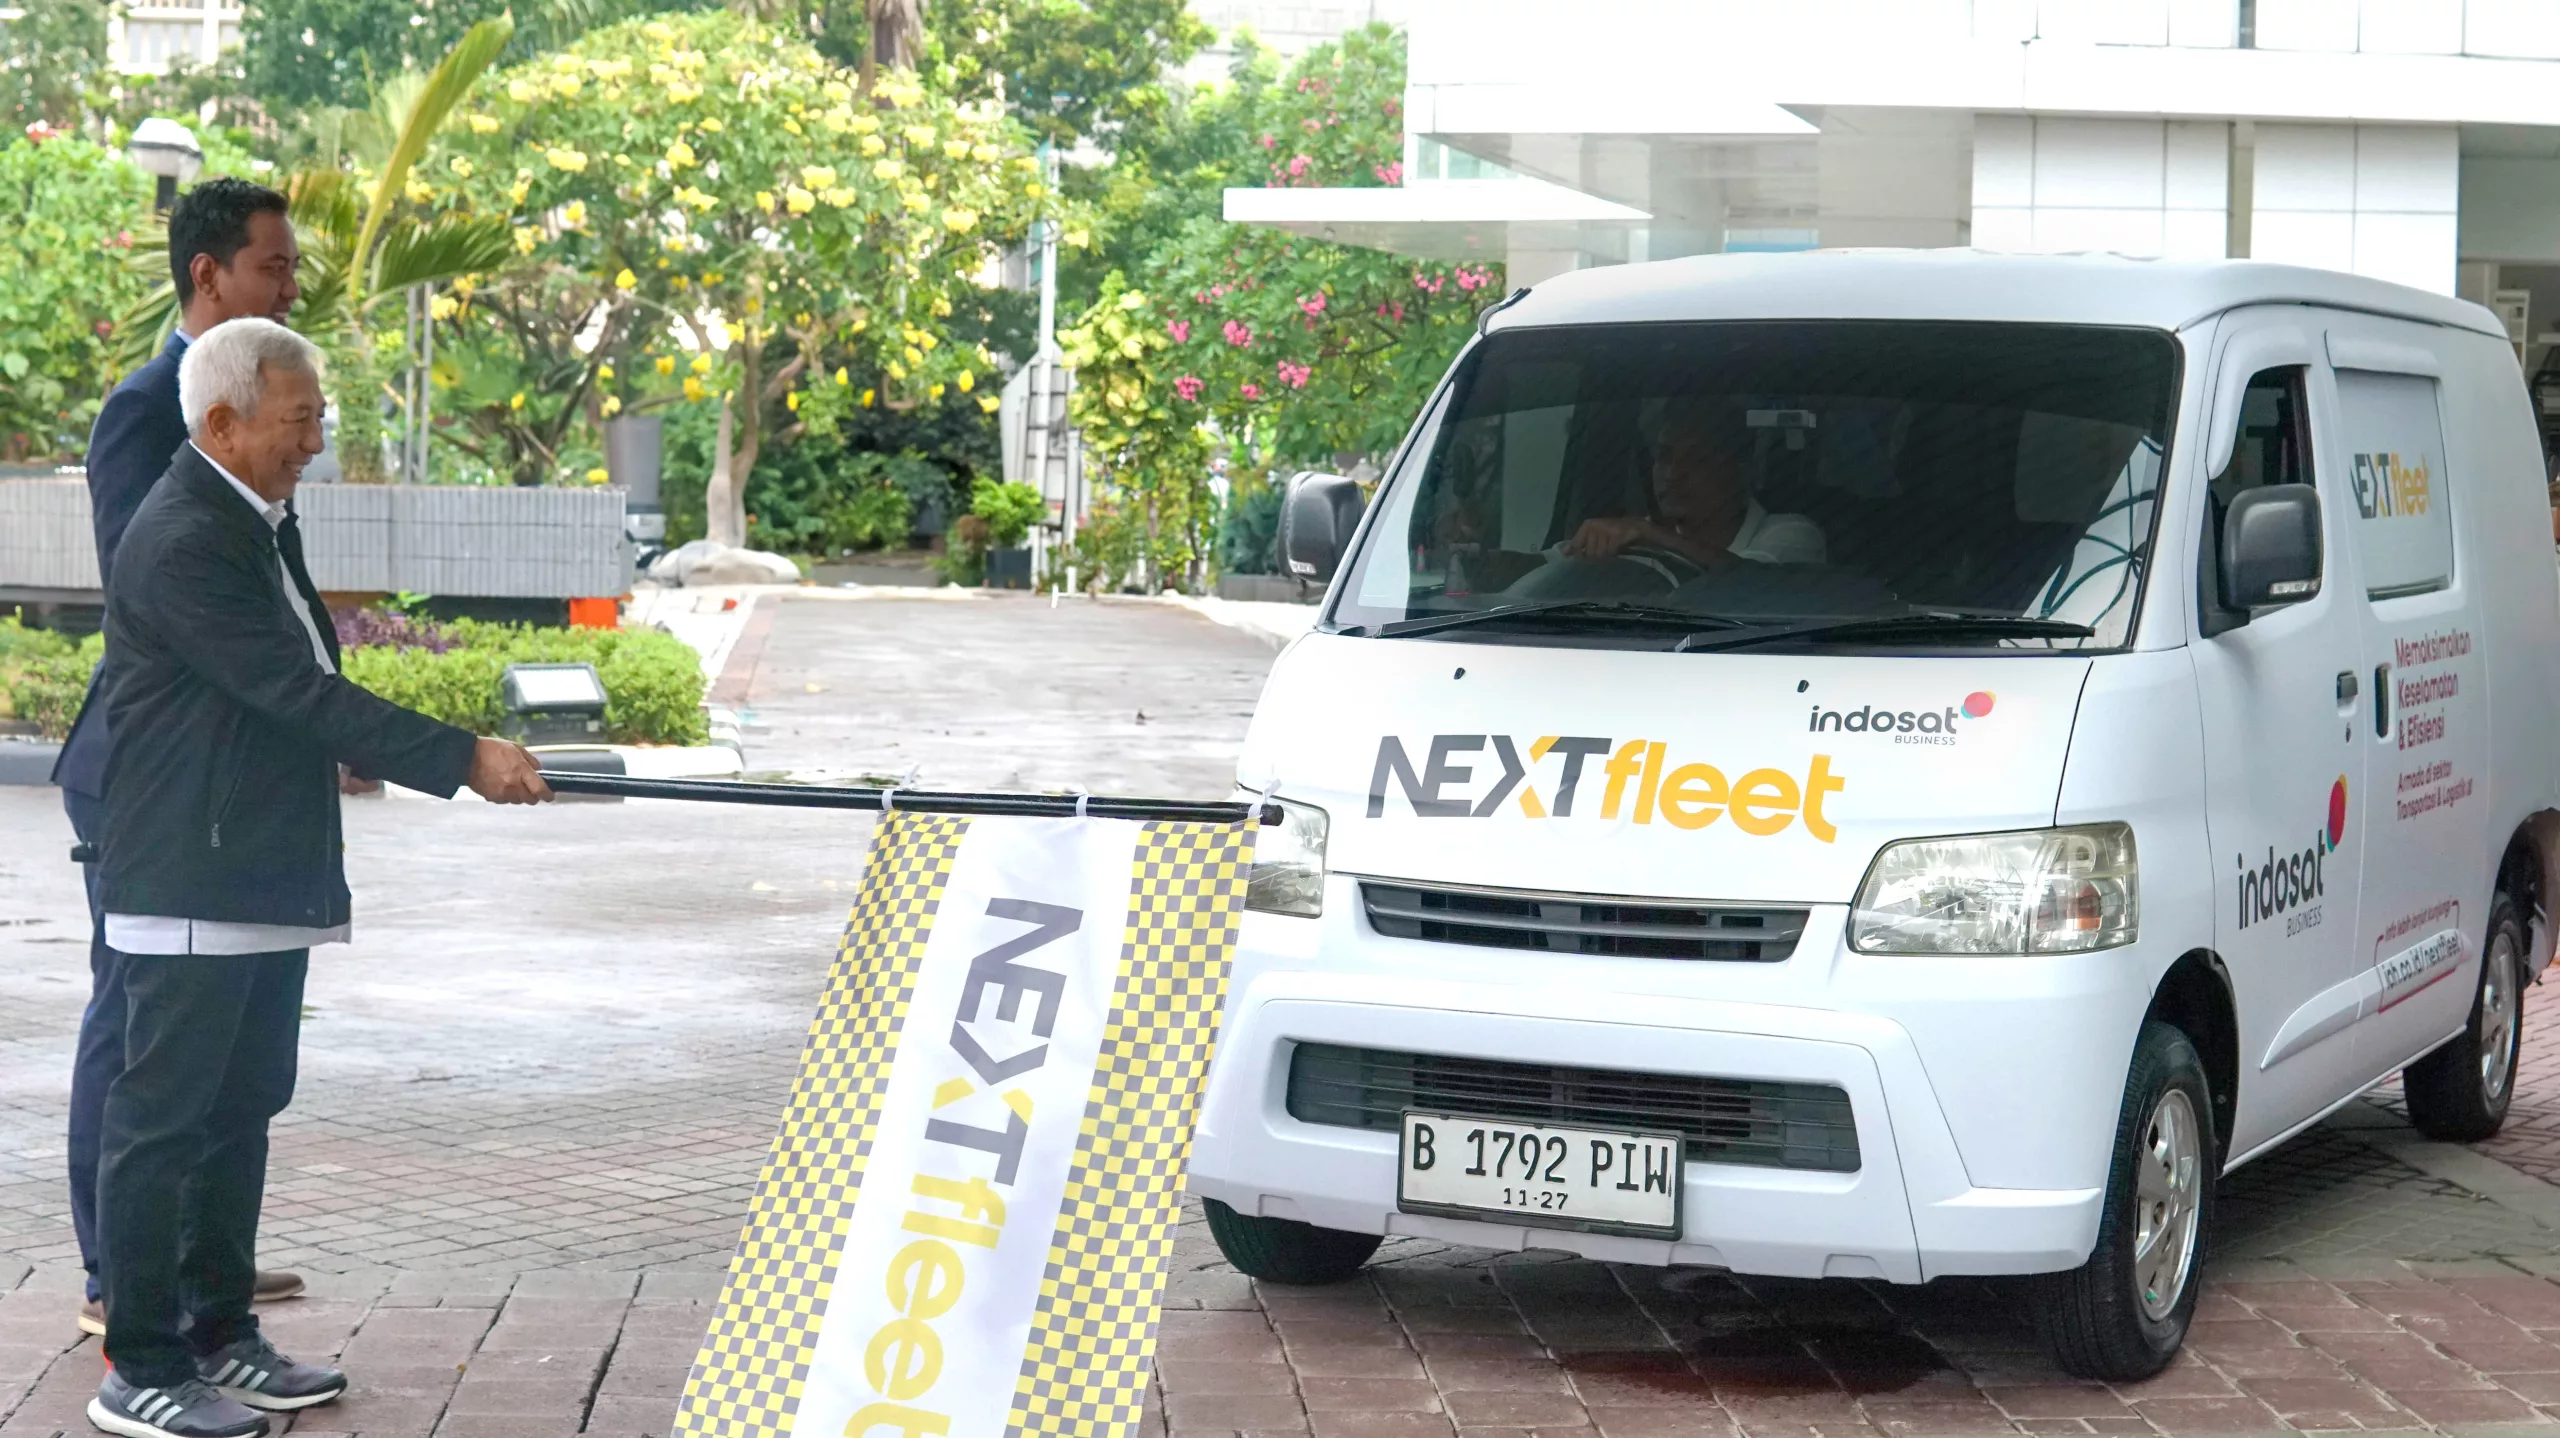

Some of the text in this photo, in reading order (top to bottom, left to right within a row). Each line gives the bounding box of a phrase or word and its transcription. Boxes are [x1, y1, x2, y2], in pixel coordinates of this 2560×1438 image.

[2350, 452, 2432, 519] NEXTfleet
[2394, 627, 2471, 669] Memaksimalkan
[2398, 671, 2459, 711] Keselamatan
[1808, 705, 1959, 734] indosat
[1894, 734, 1957, 746] BUSINESS
[2399, 706, 2445, 751] & Efisiensi
[1365, 734, 1846, 843] NEXTfleet
[2237, 829, 2326, 931] indosat
[2286, 904, 2323, 938] BUSINESS
[1412, 1122, 1670, 1195] B 1792 PIW
